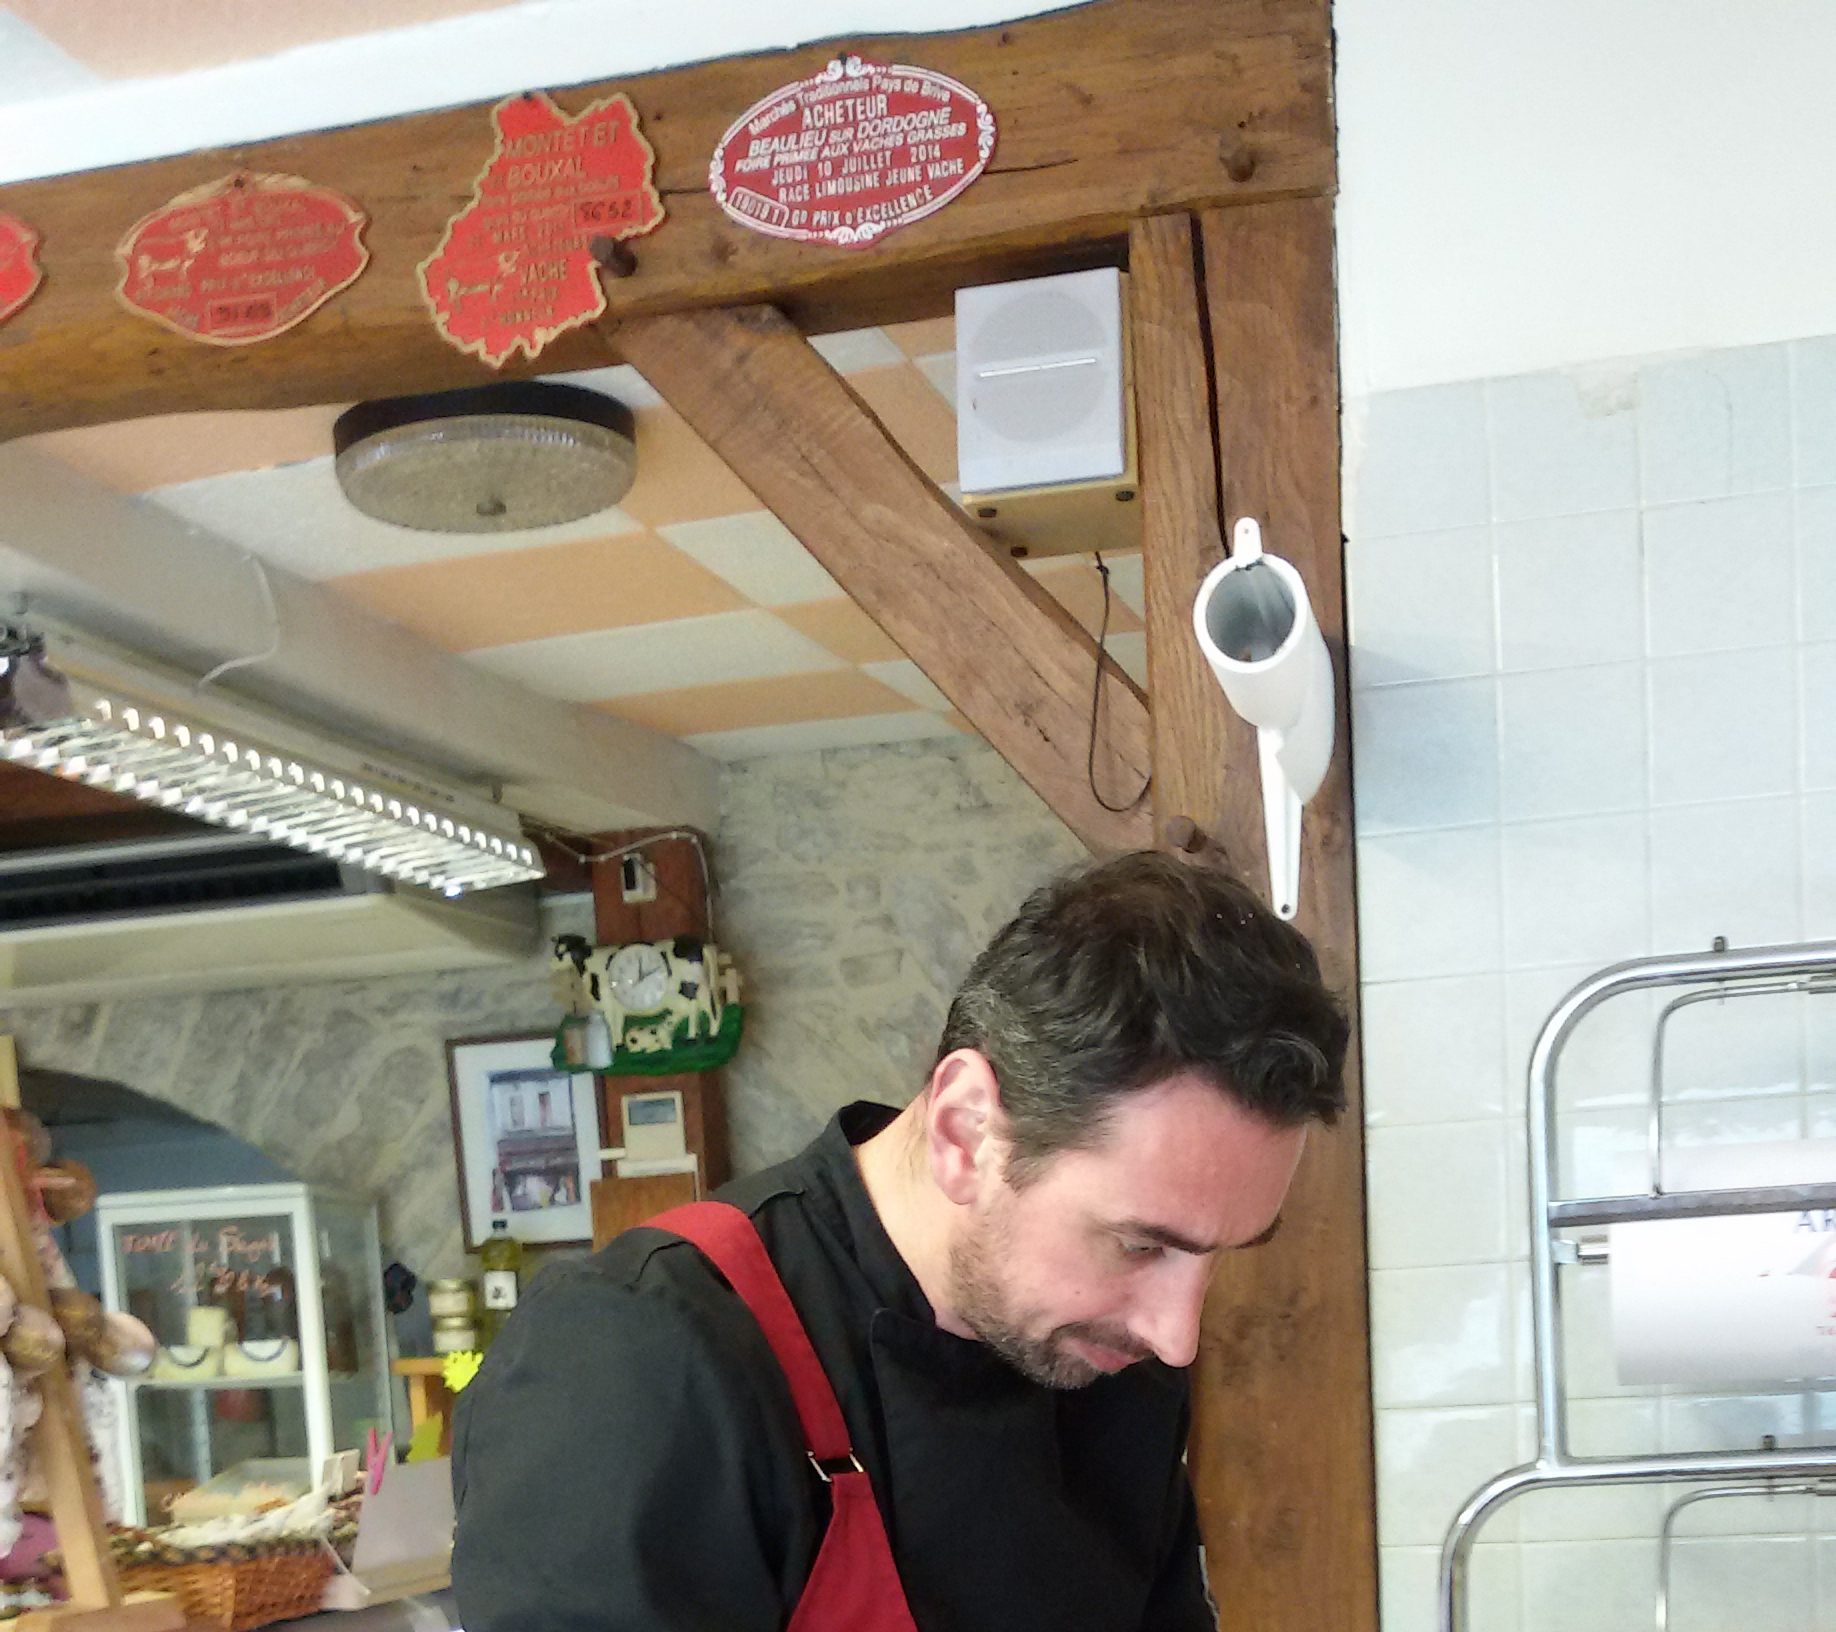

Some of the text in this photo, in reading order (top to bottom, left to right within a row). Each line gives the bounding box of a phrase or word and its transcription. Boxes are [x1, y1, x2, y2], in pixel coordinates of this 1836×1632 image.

[872, 75, 901, 94] Pays
[903, 79, 919, 94] de
[921, 80, 951, 103] Brive
[748, 106, 952, 158] BEAULIEU SUR DORDOGNE
[801, 94, 887, 130] ACHETEUR
[734, 155, 771, 173] FOIRE
[820, 140, 850, 160] AUX
[852, 131, 904, 154] VACHES
[906, 121, 967, 145] GRASSES
[771, 143, 941, 187] JEUDI 10 JUILLET 2014
[777, 158, 965, 205] RACE LIMOUSINE JEUNE VACHE
[812, 208, 841, 228] PRIX
